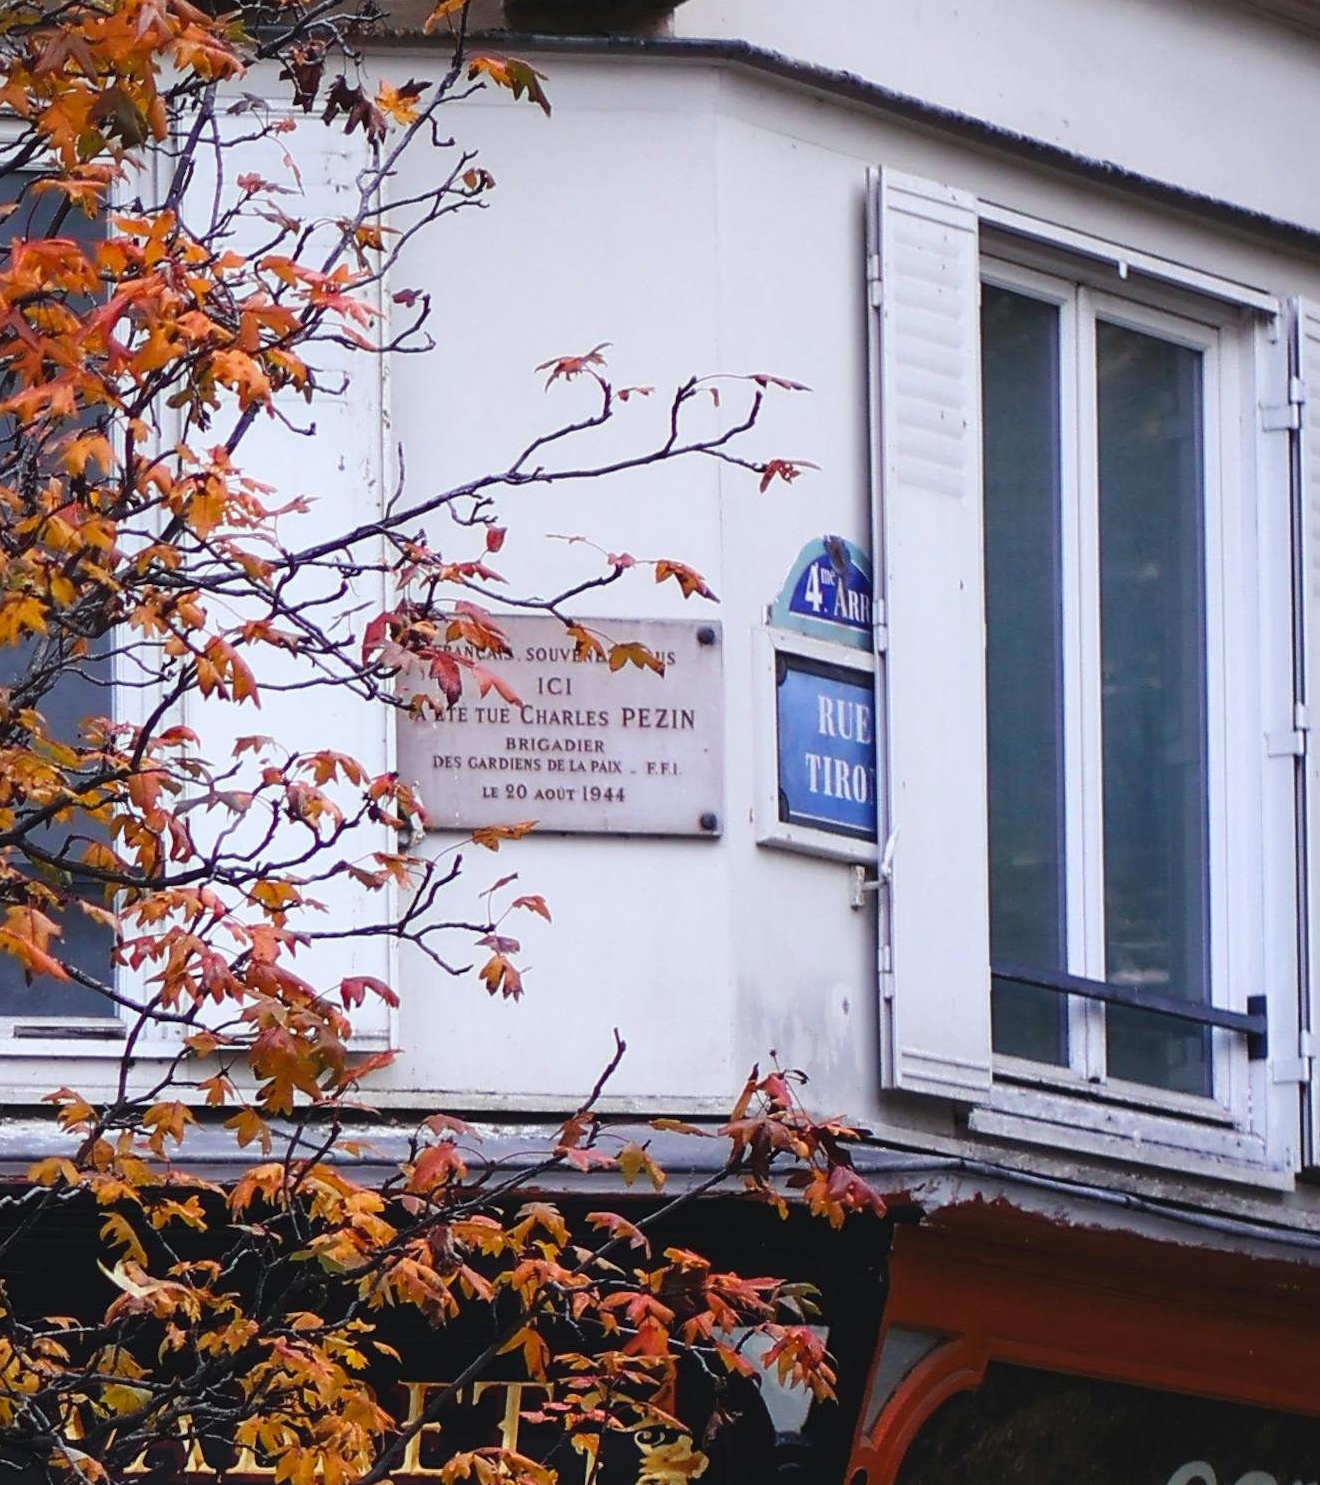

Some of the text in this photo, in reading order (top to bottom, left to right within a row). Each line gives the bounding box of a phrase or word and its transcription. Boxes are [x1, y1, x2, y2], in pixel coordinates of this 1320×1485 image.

[538, 677, 571, 696] ICI
[520, 704, 609, 727] CHARLES
[622, 707, 696, 730] PEZIN
[817, 694, 872, 745] RUE
[506, 736, 605, 754] BRIGADIER
[433, 755, 462, 769] DES
[467, 756, 541, 772] GARDIENS
[547, 758, 565, 772] DE
[569, 759, 586, 773] LA
[590, 760, 623, 774] PAIX
[805, 753, 876, 805] TIRO
[482, 785, 498, 799] LE
[506, 784, 528, 800] 20
[582, 785, 626, 803] 1944
